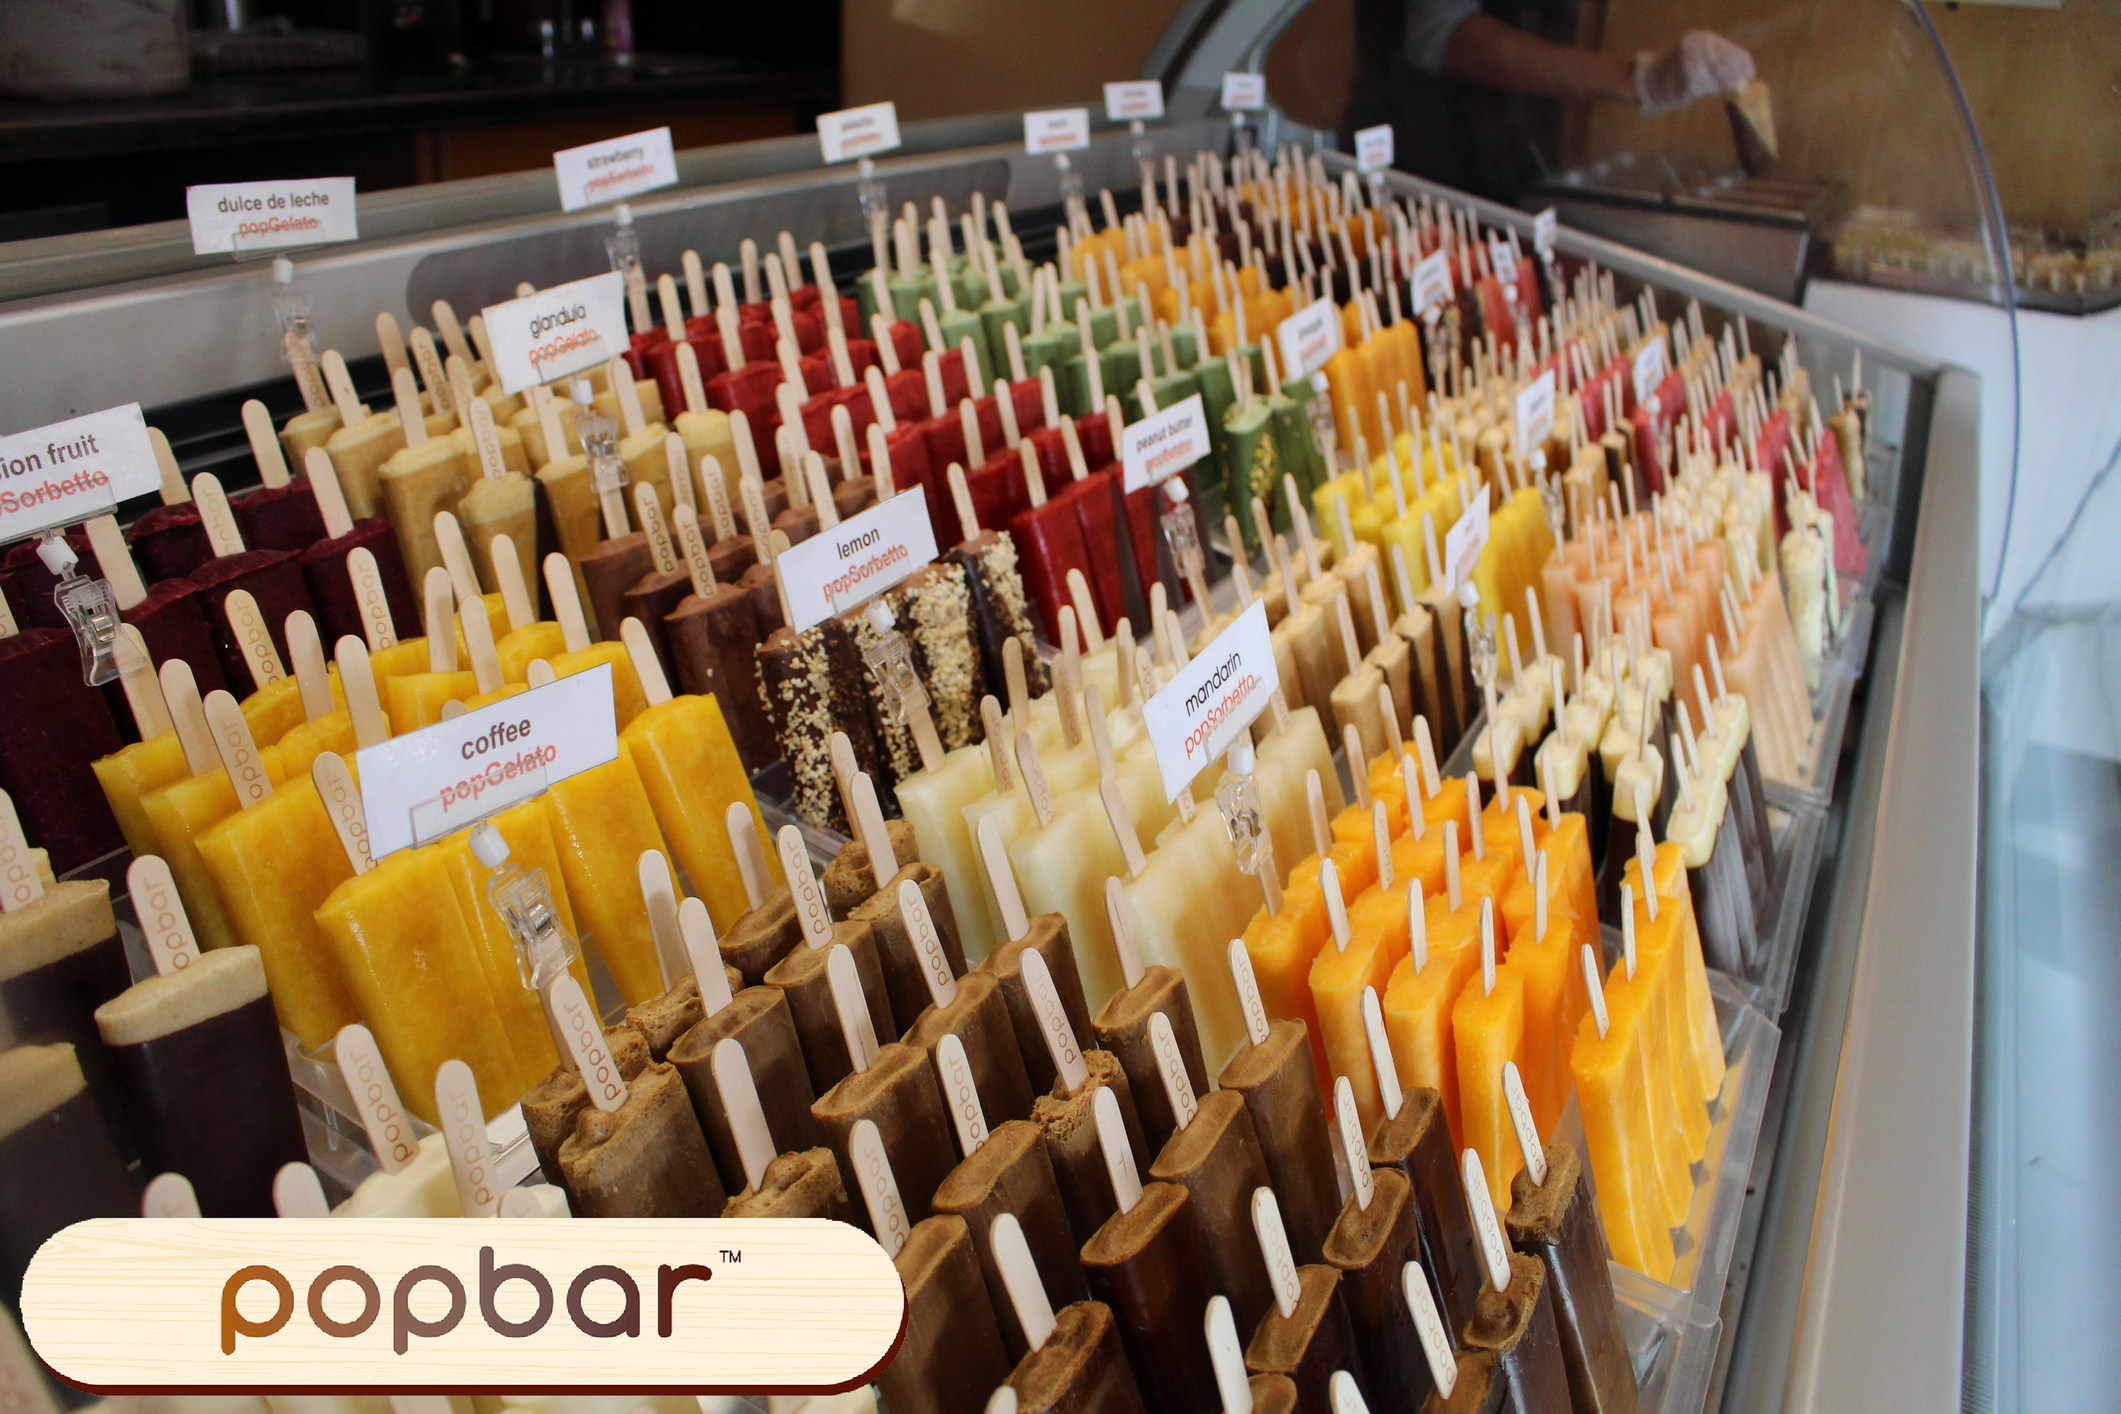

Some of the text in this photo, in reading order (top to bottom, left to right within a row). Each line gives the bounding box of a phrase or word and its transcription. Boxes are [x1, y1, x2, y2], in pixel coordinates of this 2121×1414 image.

[218, 191, 329, 213] dulce de leche
[239, 216, 319, 239] popGelato
[529, 328, 599, 368] popGelato
[0, 434, 100, 481] ion fruit
[0, 470, 109, 517] Sorbetto
[822, 544, 909, 603] popSorbetto
[836, 528, 880, 560] lemon
[1184, 673, 1255, 760] popSorbetto
[1185, 652, 1242, 717] mandarin
[220, 719, 263, 799] opbar
[440, 744, 557, 813] popGelato
[461, 718, 531, 760] coffee
[143, 877, 190, 970] opbar
[787, 841, 827, 935] popbar
[906, 896, 951, 986] popbar
[563, 1001, 622, 1102] popbar
[1032, 973, 1083, 1065] popbar
[350, 1050, 414, 1163] popbar
[452, 1090, 495, 1206] popbar
[1343, 1098, 1370, 1189] popbar
[1511, 1086, 1544, 1174] popbar
[1472, 1172, 1503, 1267] popbar
